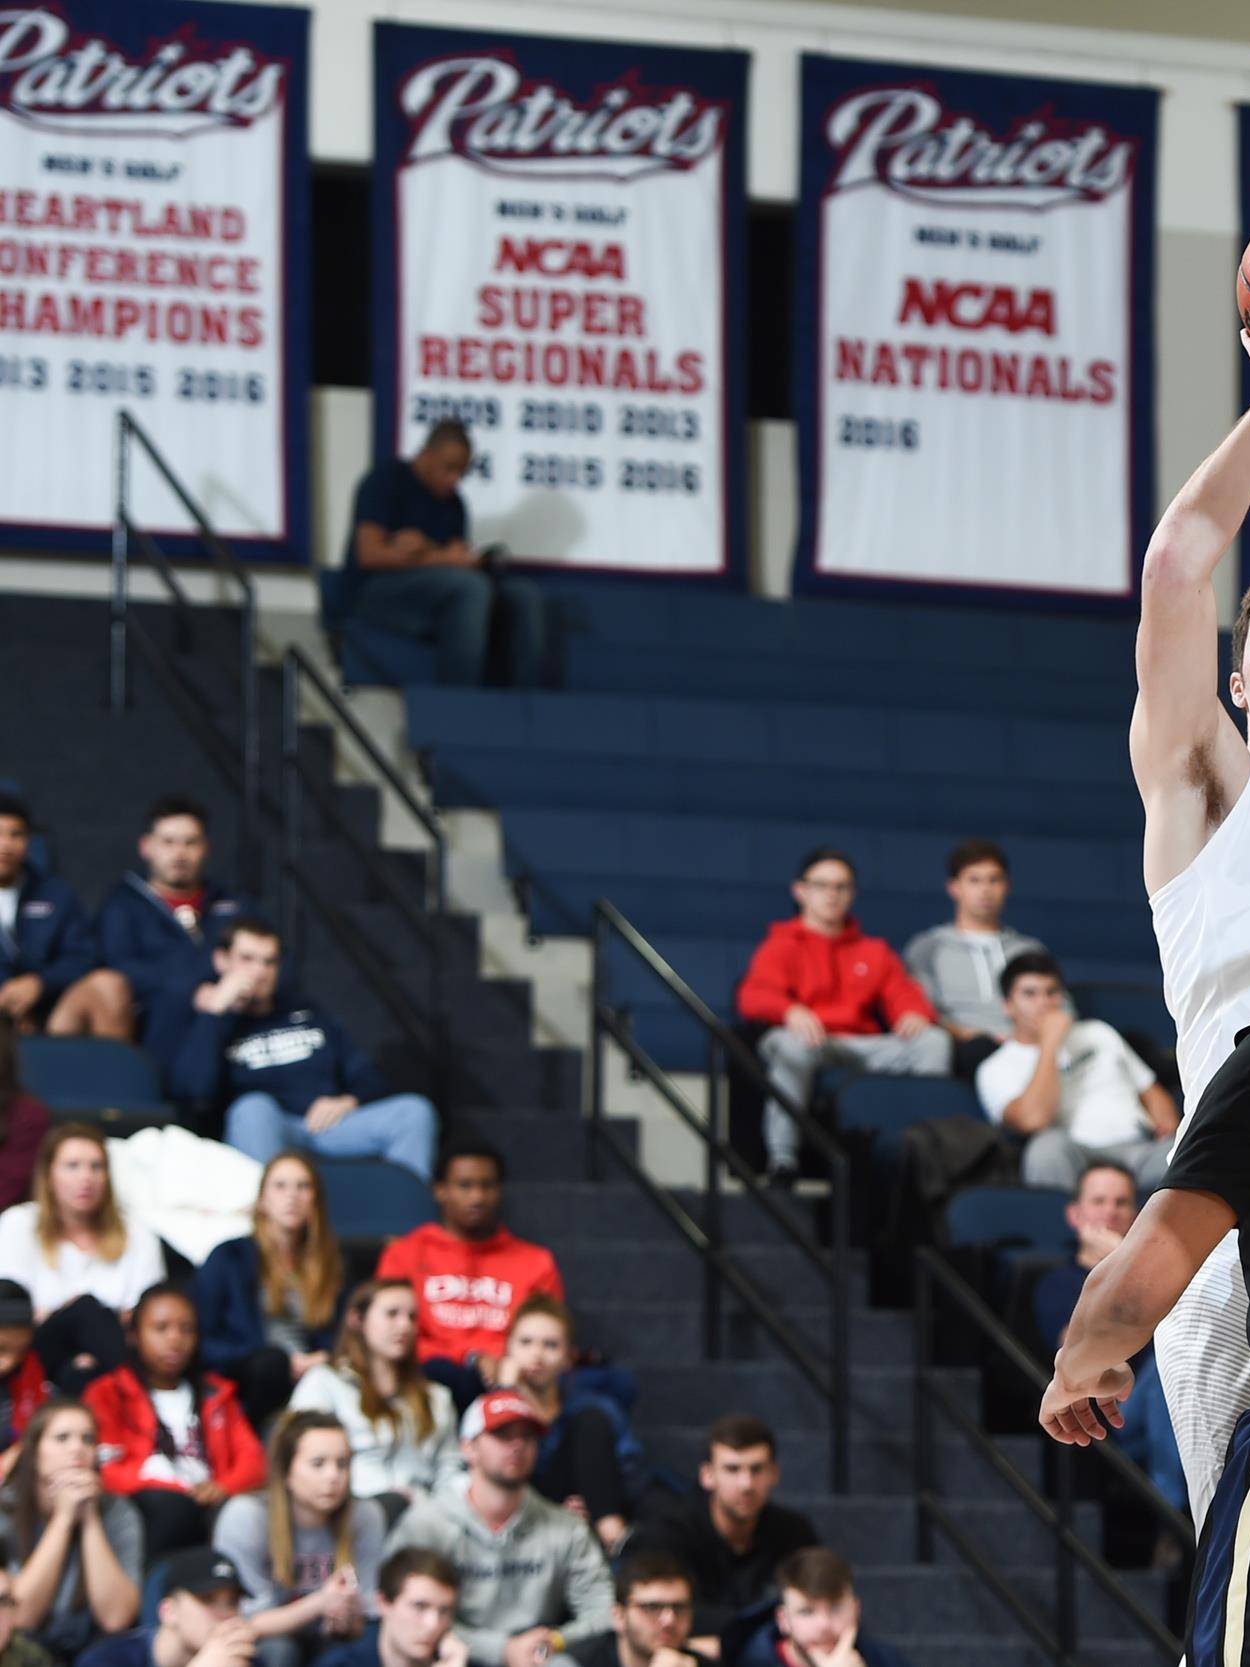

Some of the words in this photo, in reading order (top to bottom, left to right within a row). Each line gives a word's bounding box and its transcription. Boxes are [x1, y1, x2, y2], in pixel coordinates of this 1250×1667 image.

[402, 56, 724, 162] Patriots
[827, 88, 1135, 192] Patriots
[495, 234, 626, 281] NCAA
[477, 285, 648, 338] SUPER
[898, 275, 1057, 340] NCAA
[67, 359, 156, 396] 2015
[177, 366, 267, 404] 2016
[417, 336, 706, 396] REGIONALS
[834, 335, 1117, 406] NATIONALS
[838, 413, 919, 454] 2016
[520, 454, 604, 487] 2015
[619, 457, 701, 493] 2016
